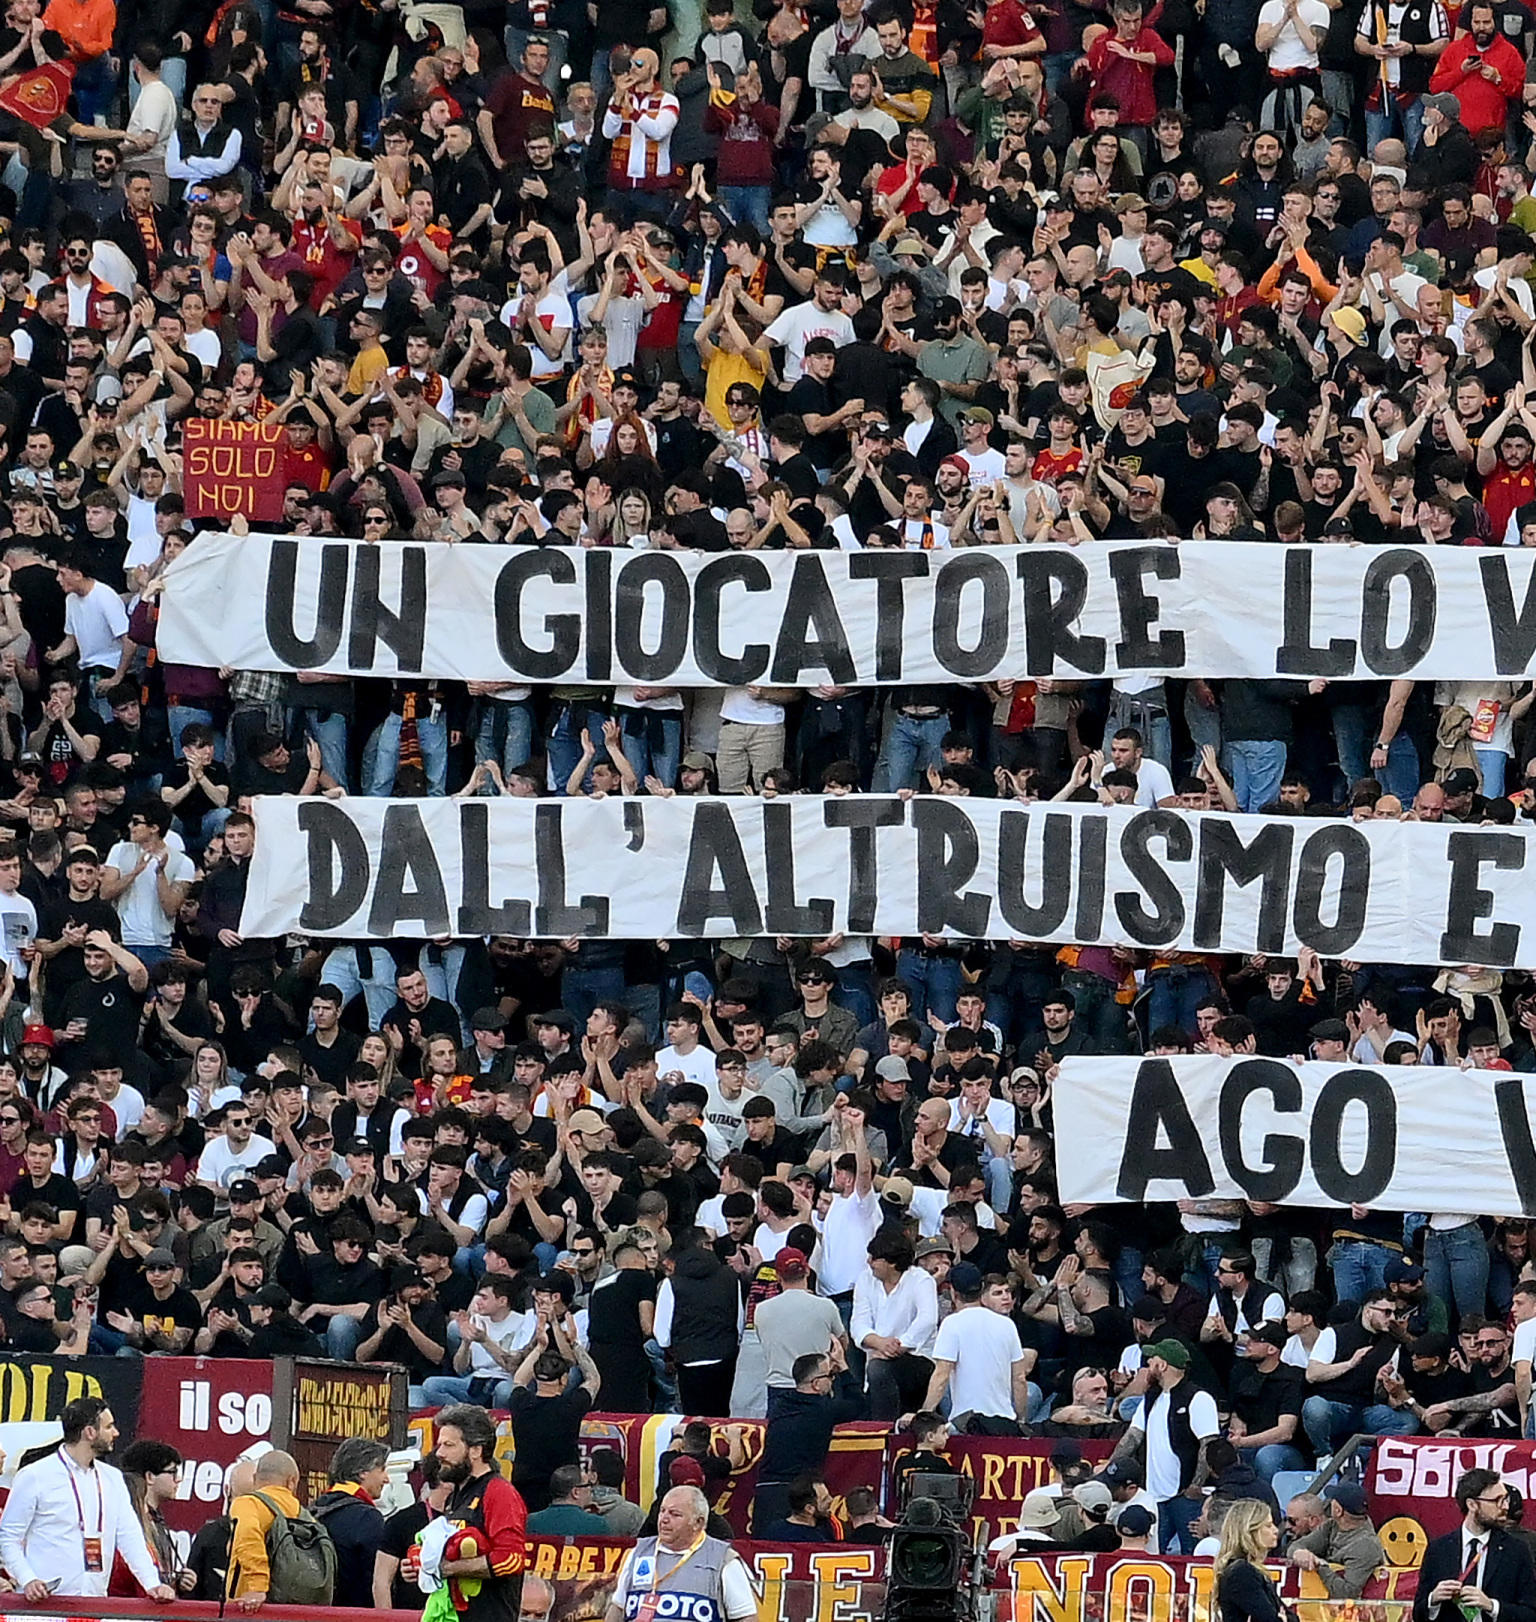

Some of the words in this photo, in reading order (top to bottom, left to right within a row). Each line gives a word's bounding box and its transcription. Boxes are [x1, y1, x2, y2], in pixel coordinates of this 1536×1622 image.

[187, 417, 283, 442] SIAMO
[190, 446, 275, 477] SOLO
[198, 482, 254, 513] NOI
[266, 541, 426, 673] UN
[497, 545, 1185, 685] GIOCATORE
[1276, 549, 1436, 677] LO
[1440, 832, 1525, 967] E
[1117, 1058, 1398, 1207] AGO
[179, 1381, 210, 1431] il
